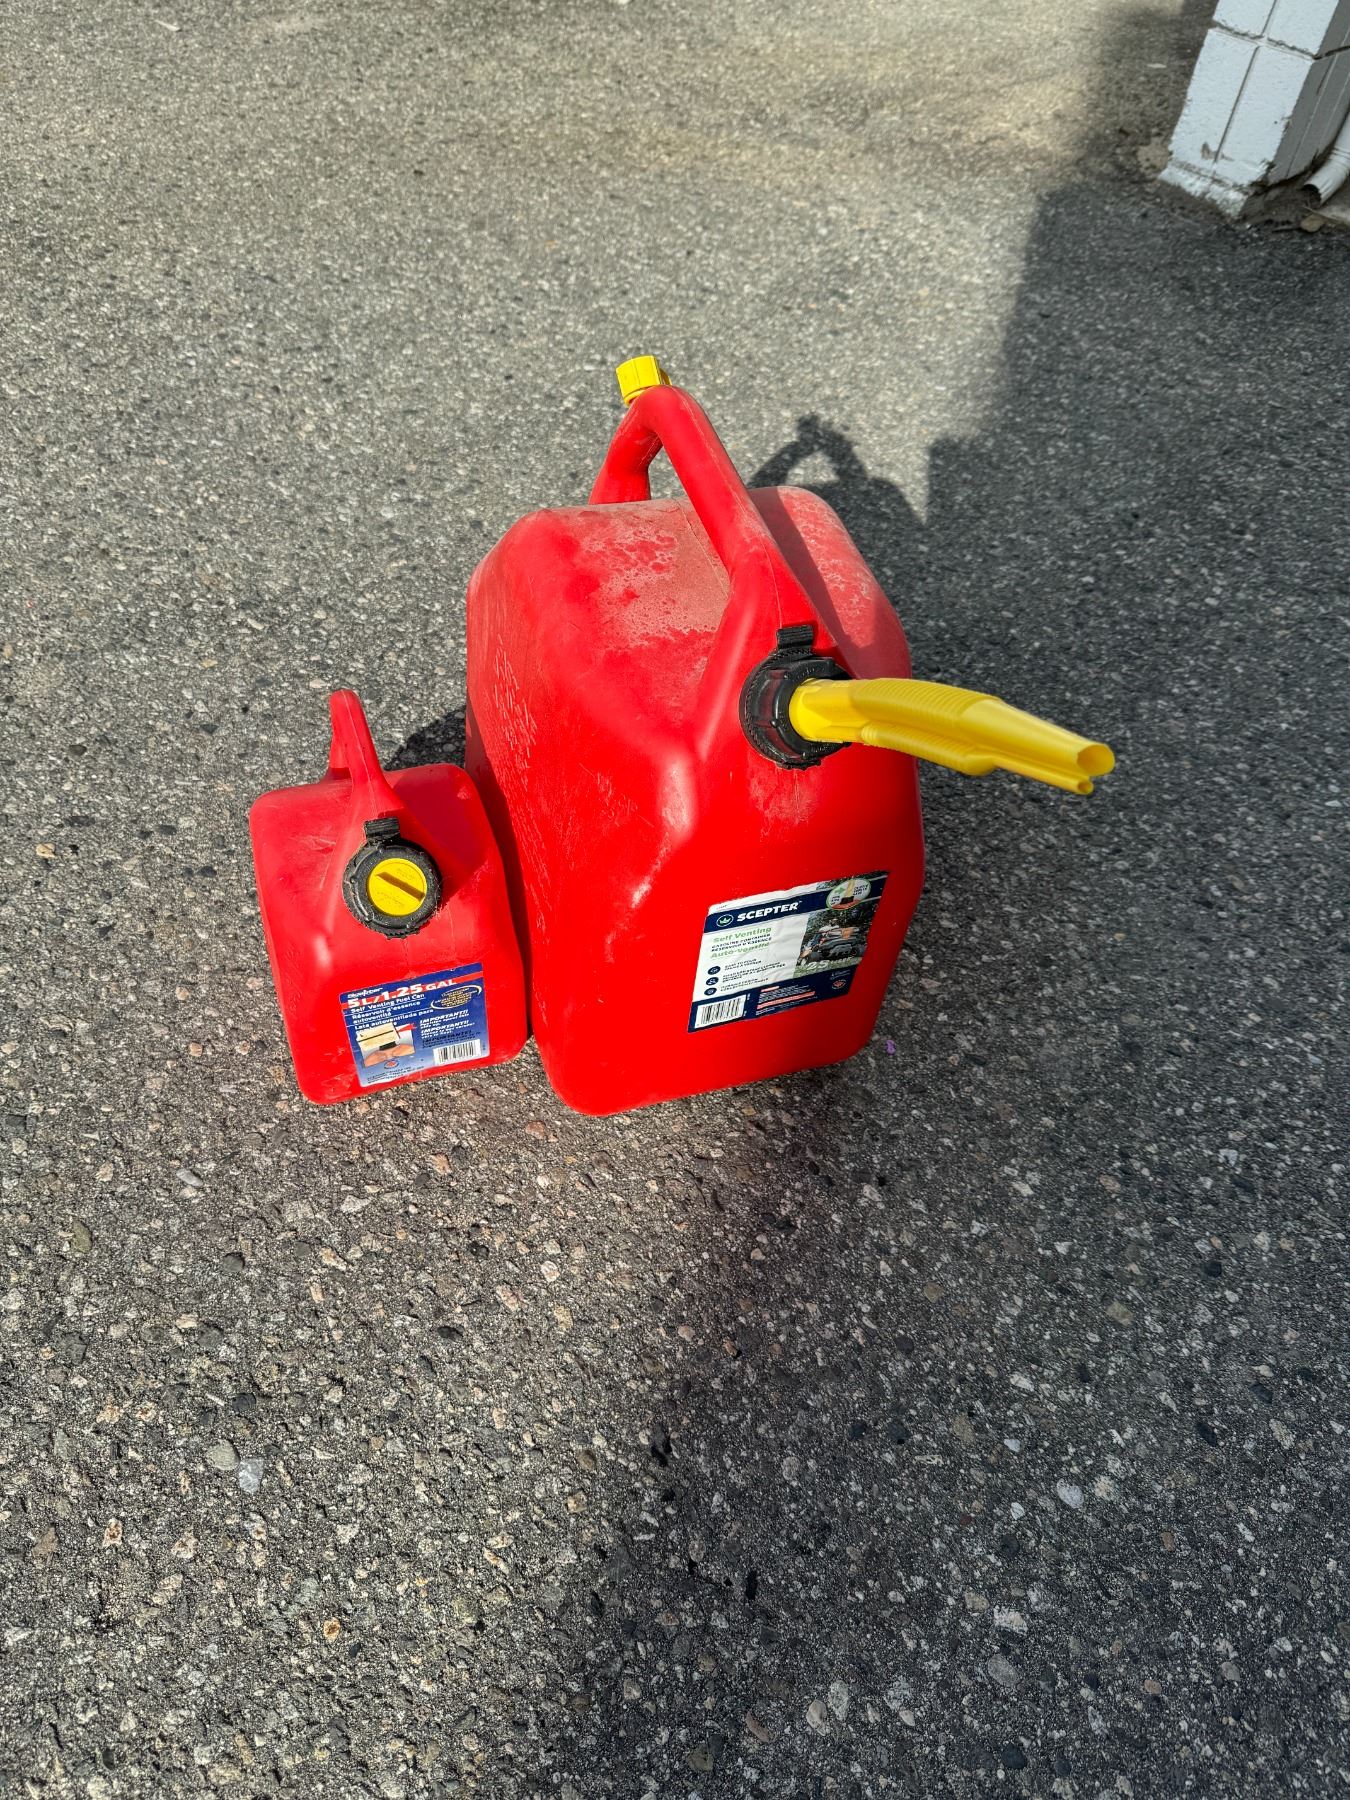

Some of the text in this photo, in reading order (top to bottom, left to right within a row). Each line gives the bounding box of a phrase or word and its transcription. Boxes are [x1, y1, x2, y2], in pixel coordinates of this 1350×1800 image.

[737, 902, 799, 922] SCEPTER
[713, 927, 772, 943] Self Venting
[425, 979, 457, 991] GAL
[350, 1006, 366, 1014] Self
[367, 1000, 395, 1010] Venting
